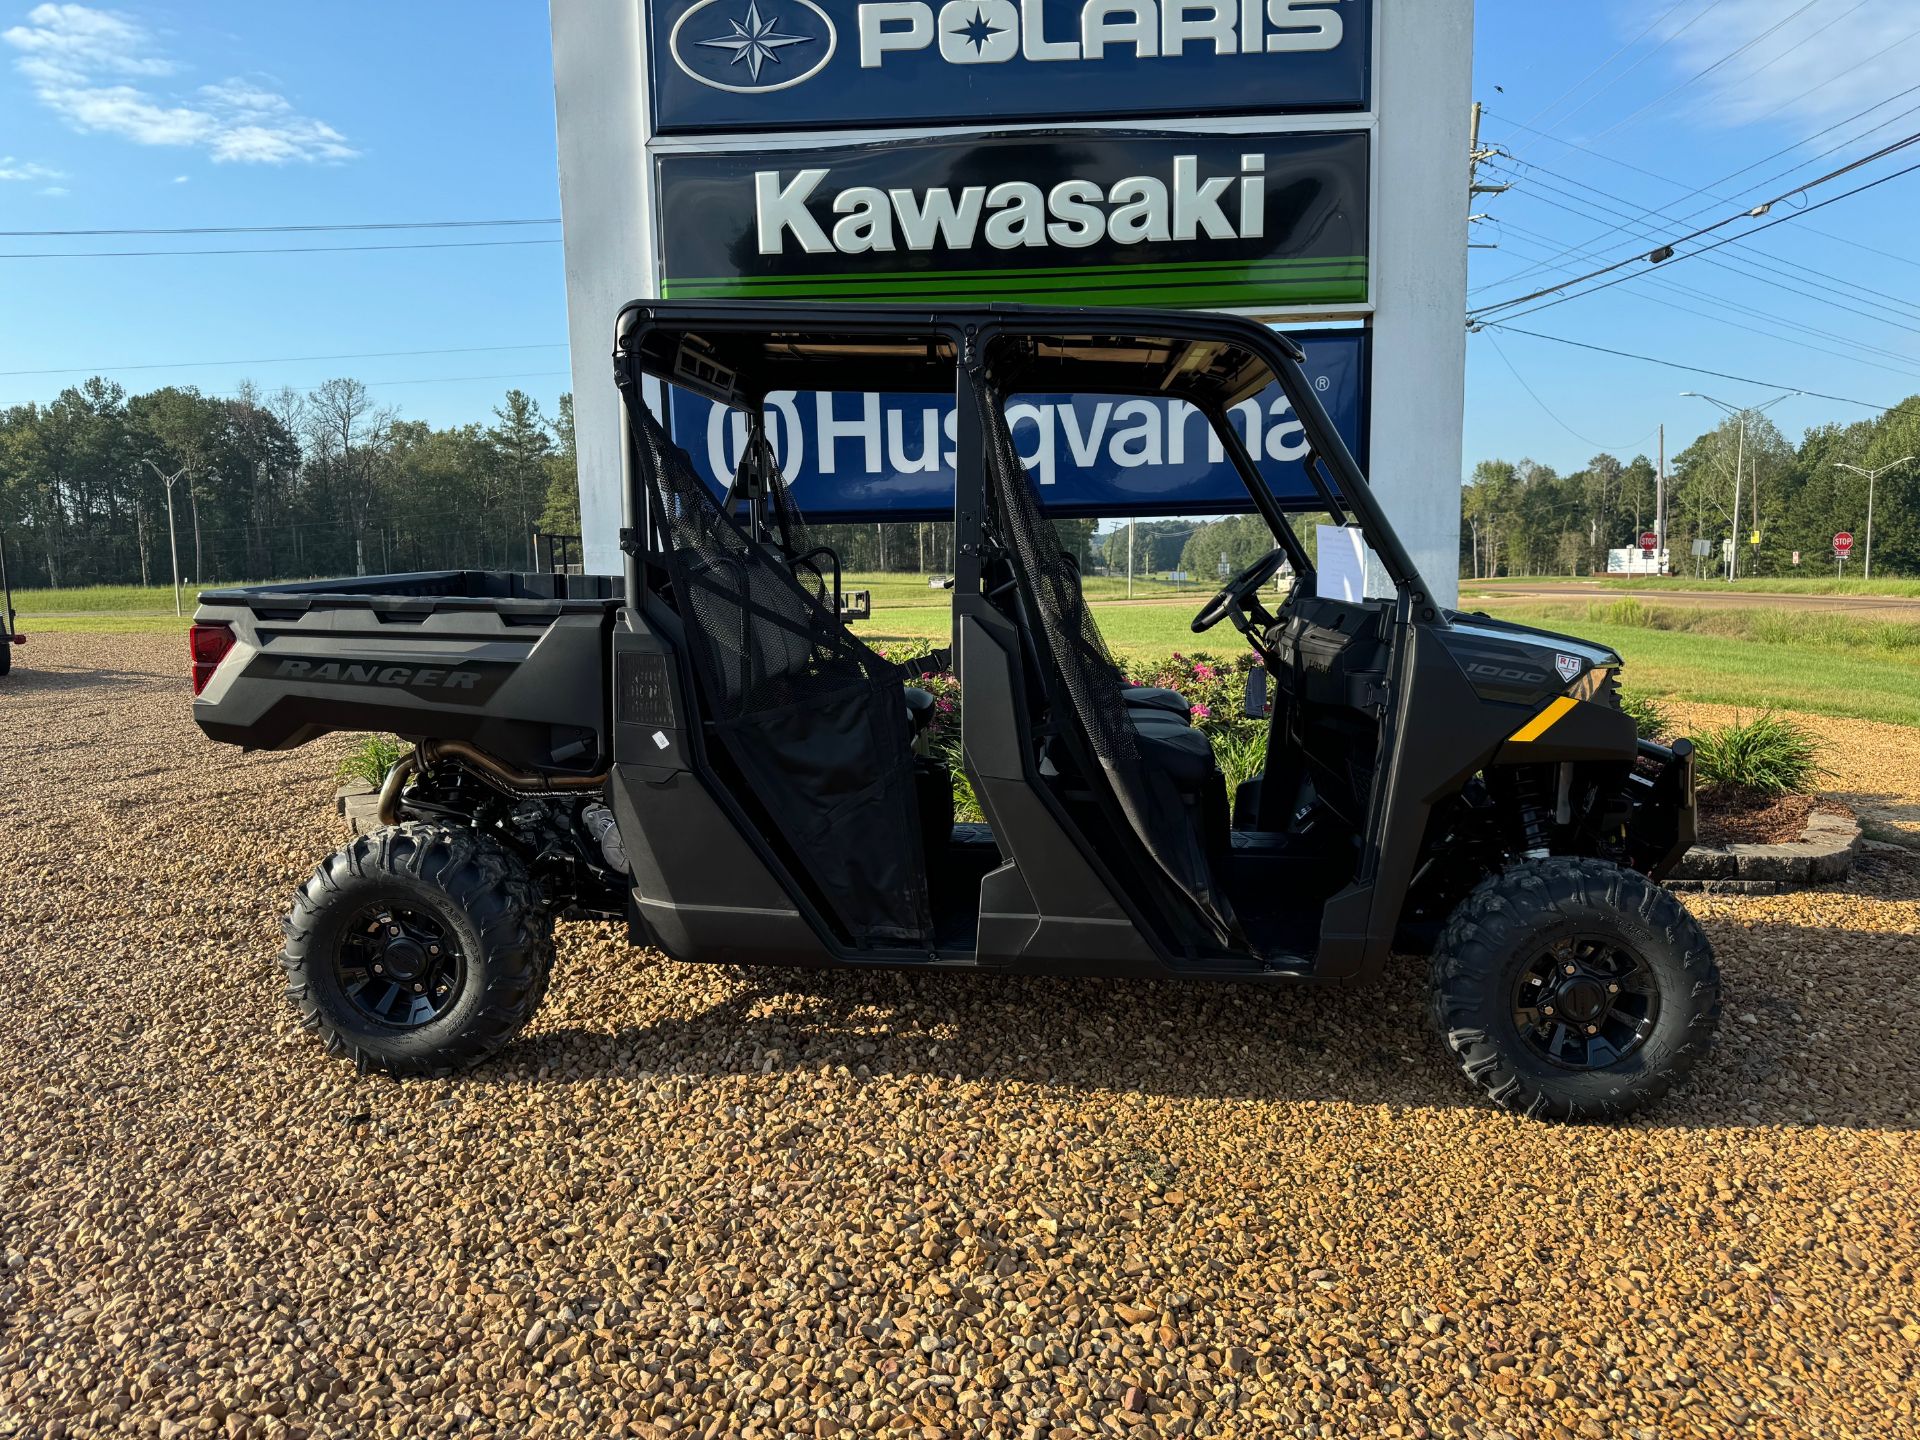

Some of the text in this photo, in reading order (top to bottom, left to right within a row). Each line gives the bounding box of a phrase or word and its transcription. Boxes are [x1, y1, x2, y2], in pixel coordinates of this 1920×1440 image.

[858, 0, 1345, 68] POLARIS
[753, 153, 1265, 256] Kawasaki
[1641, 537, 1657, 546] STOP
[1834, 537, 1852, 546] STOP
[275, 660, 483, 690] RANGER
[1466, 663, 1548, 683] 1000
